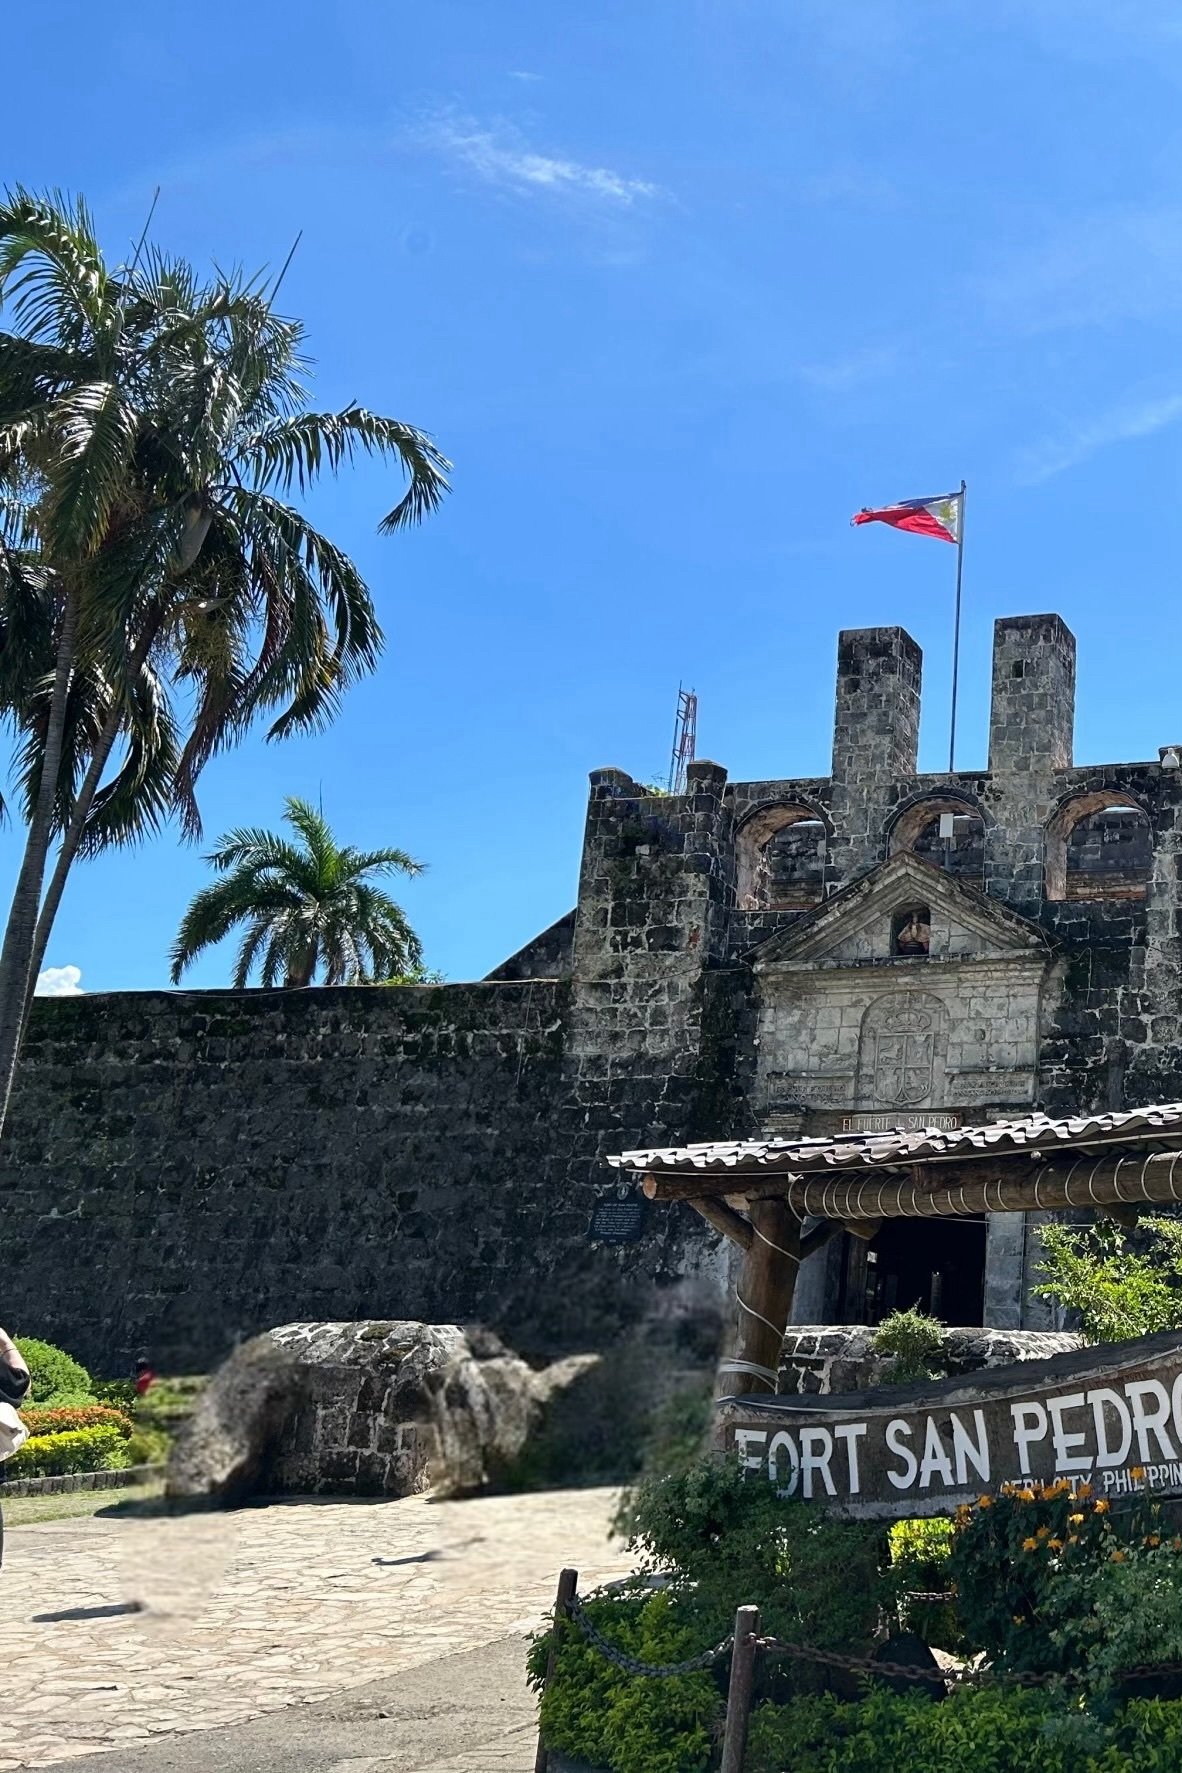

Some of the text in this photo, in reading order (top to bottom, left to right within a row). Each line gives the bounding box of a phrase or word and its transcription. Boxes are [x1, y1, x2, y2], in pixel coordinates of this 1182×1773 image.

[908, 1116, 926, 1129] SAN
[928, 1116, 957, 1129] PEDRO
[734, 1423, 867, 1498] FORT
[885, 1409, 990, 1489] SAN
[1053, 1473, 1093, 1496] CTY
